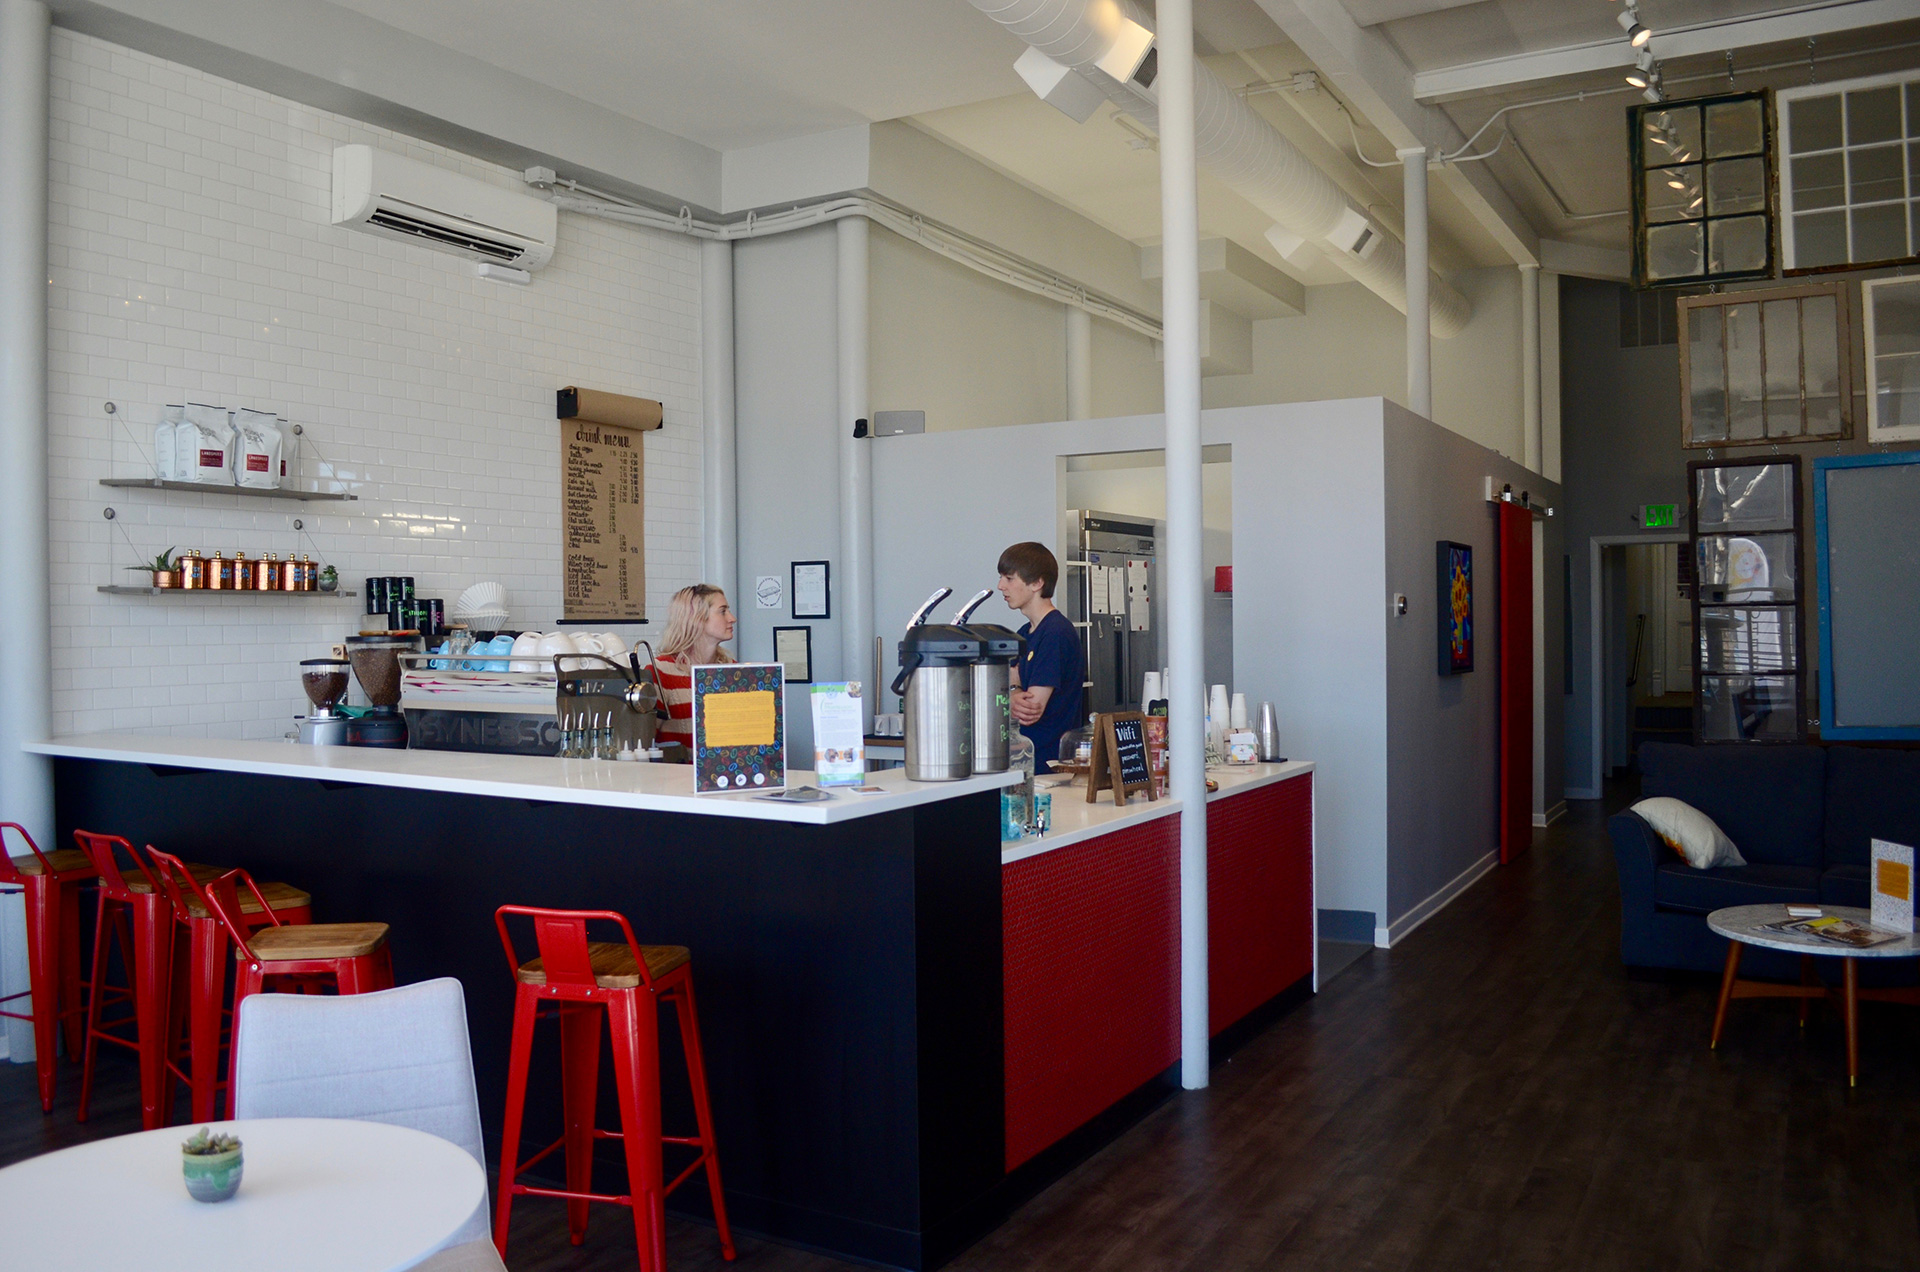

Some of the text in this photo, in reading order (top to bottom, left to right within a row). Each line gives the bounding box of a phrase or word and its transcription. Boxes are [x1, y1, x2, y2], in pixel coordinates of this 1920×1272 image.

[576, 424, 631, 448] drink menu
[1646, 504, 1675, 527] EXIT
[420, 715, 561, 747] SYNESSO
[1115, 726, 1136, 741] WiFi
